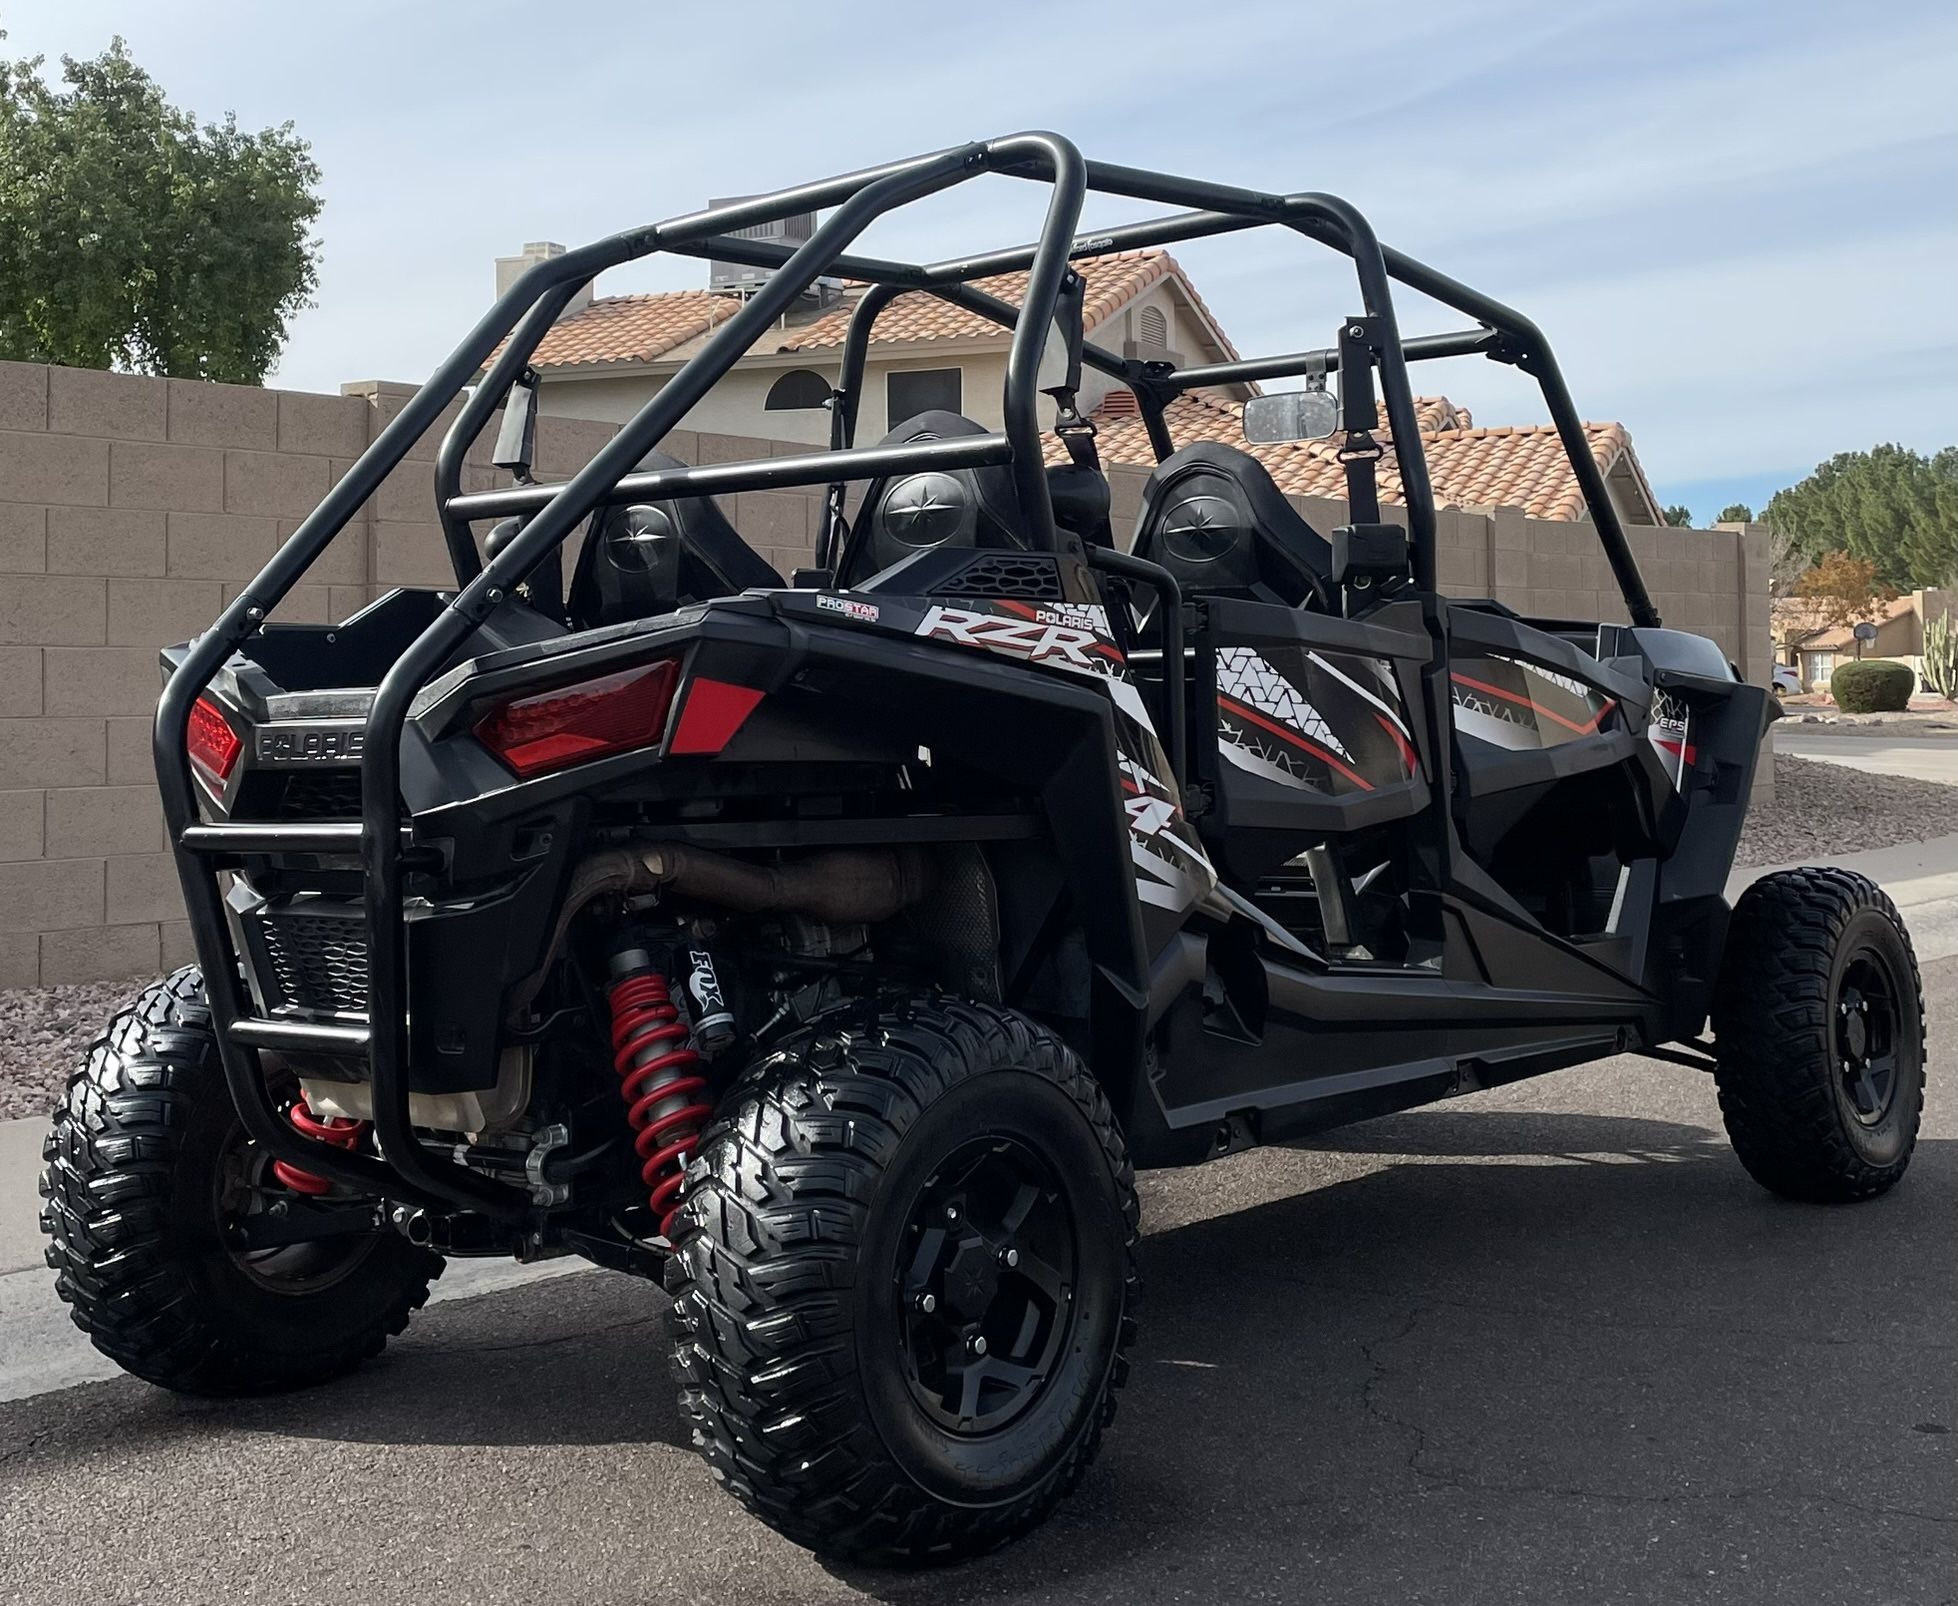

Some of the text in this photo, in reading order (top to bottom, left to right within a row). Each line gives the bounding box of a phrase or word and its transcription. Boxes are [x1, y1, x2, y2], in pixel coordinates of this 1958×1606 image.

[914, 605, 1096, 665] RZR
[1036, 610, 1094, 631] POLARIS
[1660, 717, 1685, 731] EPS
[689, 950, 724, 1013] FOX
